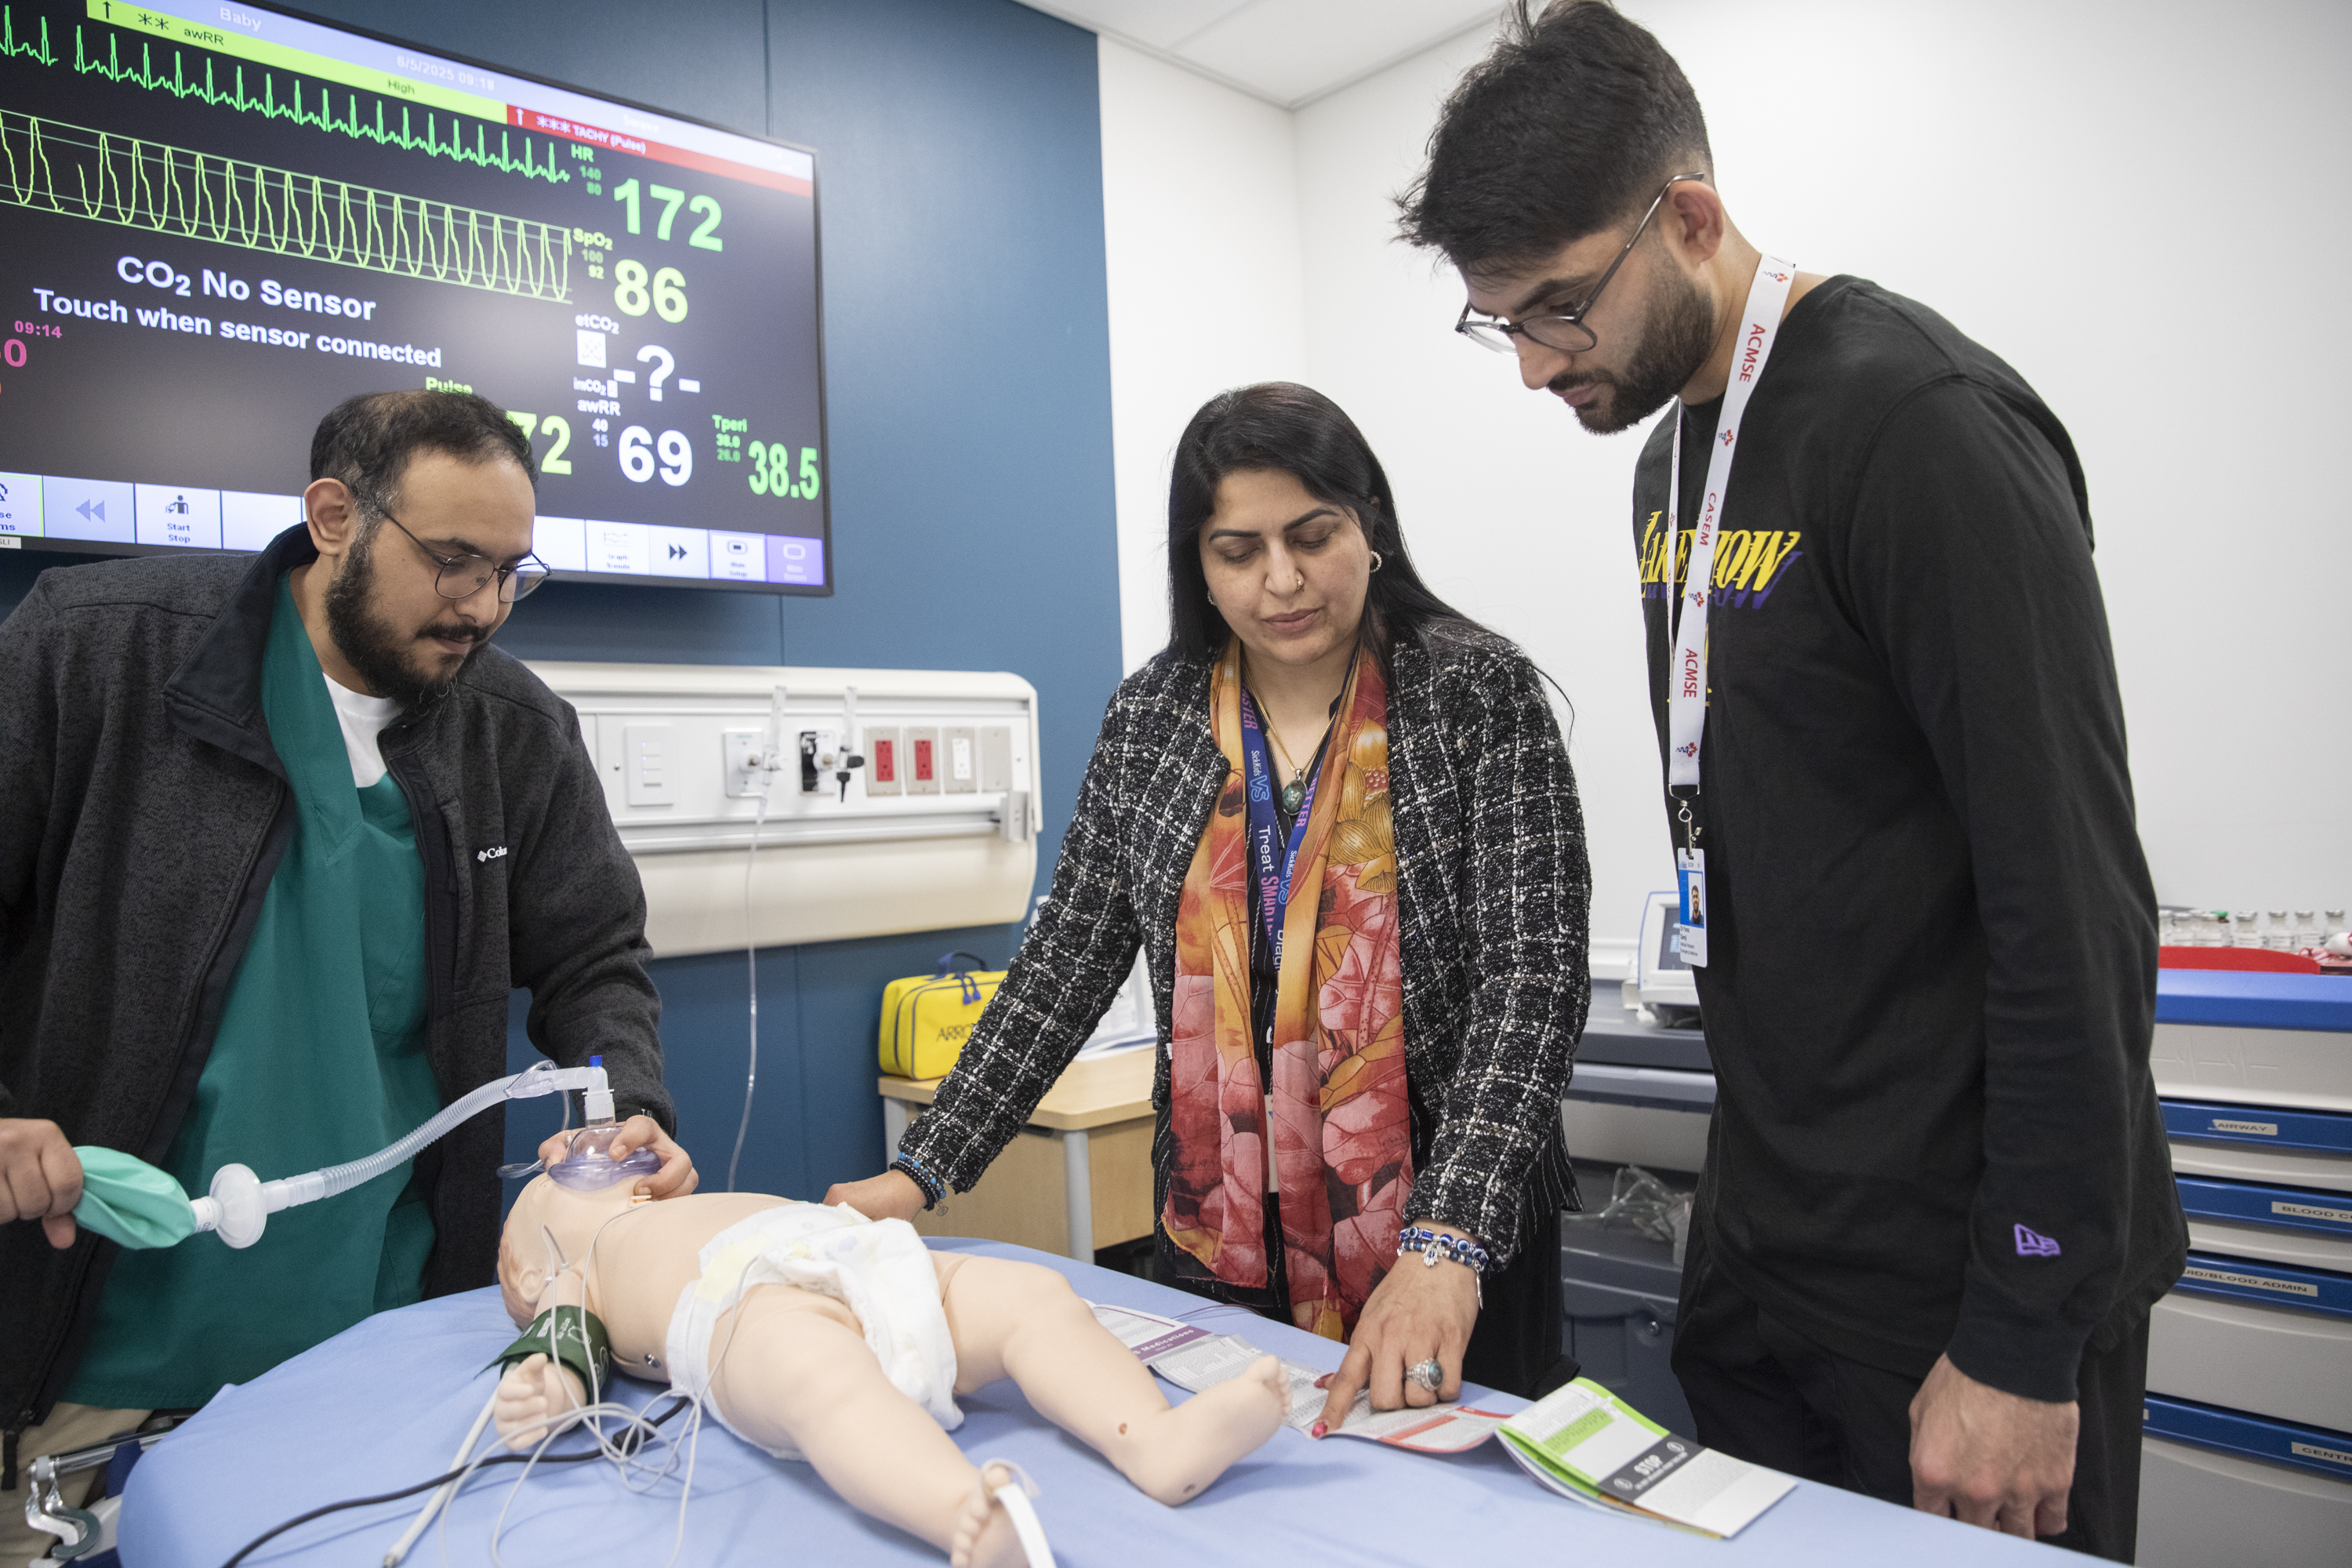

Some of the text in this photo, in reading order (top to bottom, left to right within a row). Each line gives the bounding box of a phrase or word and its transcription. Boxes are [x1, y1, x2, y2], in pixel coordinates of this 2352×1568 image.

[220, 6, 262, 32] Baby
[184, 28, 223, 45] awRR
[397, 55, 455, 82] 6/5/2025
[387, 79, 416, 95] High
[572, 123, 610, 143] TACHY
[571, 143, 594, 163] HR
[579, 164, 602, 181] 140
[613, 177, 724, 252] 172
[572, 227, 613, 251] SpO2
[116, 255, 376, 321] CO2 No Sensor
[614, 258, 689, 324] 86
[14, 320, 63, 339] 09:14
[33, 287, 442, 368] Touch when sensor connected
[1738, 322, 1766, 383] ACMSE
[576, 398, 622, 417] awRR
[591, 417, 609, 433] 40
[506, 410, 572, 476] 72
[617, 424, 693, 487] 69
[747, 439, 820, 501] 38.5
[167, 523, 191, 532] Start
[1699, 492, 1717, 546] CASEM
[168, 534, 191, 543] Stop
[1683, 648, 1699, 699] ACMSE
[1250, 750, 1262, 777] SickKids
[1250, 775, 1270, 802] VS
[487, 846, 508, 859] Colu
[1258, 824, 1274, 873] Treat
[935, 1023, 974, 1042] ARRO
[2217, 1122, 2268, 1132] AIRWAY
[2281, 1205, 2335, 1218] BLOOD
[2183, 1269, 2307, 1293] UID/BLOOD ADMIN
[1141, 1328, 1195, 1352] Medications
[1633, 1454, 1664, 1476] STOP
[2302, 1446, 2352, 1463] CENTR
